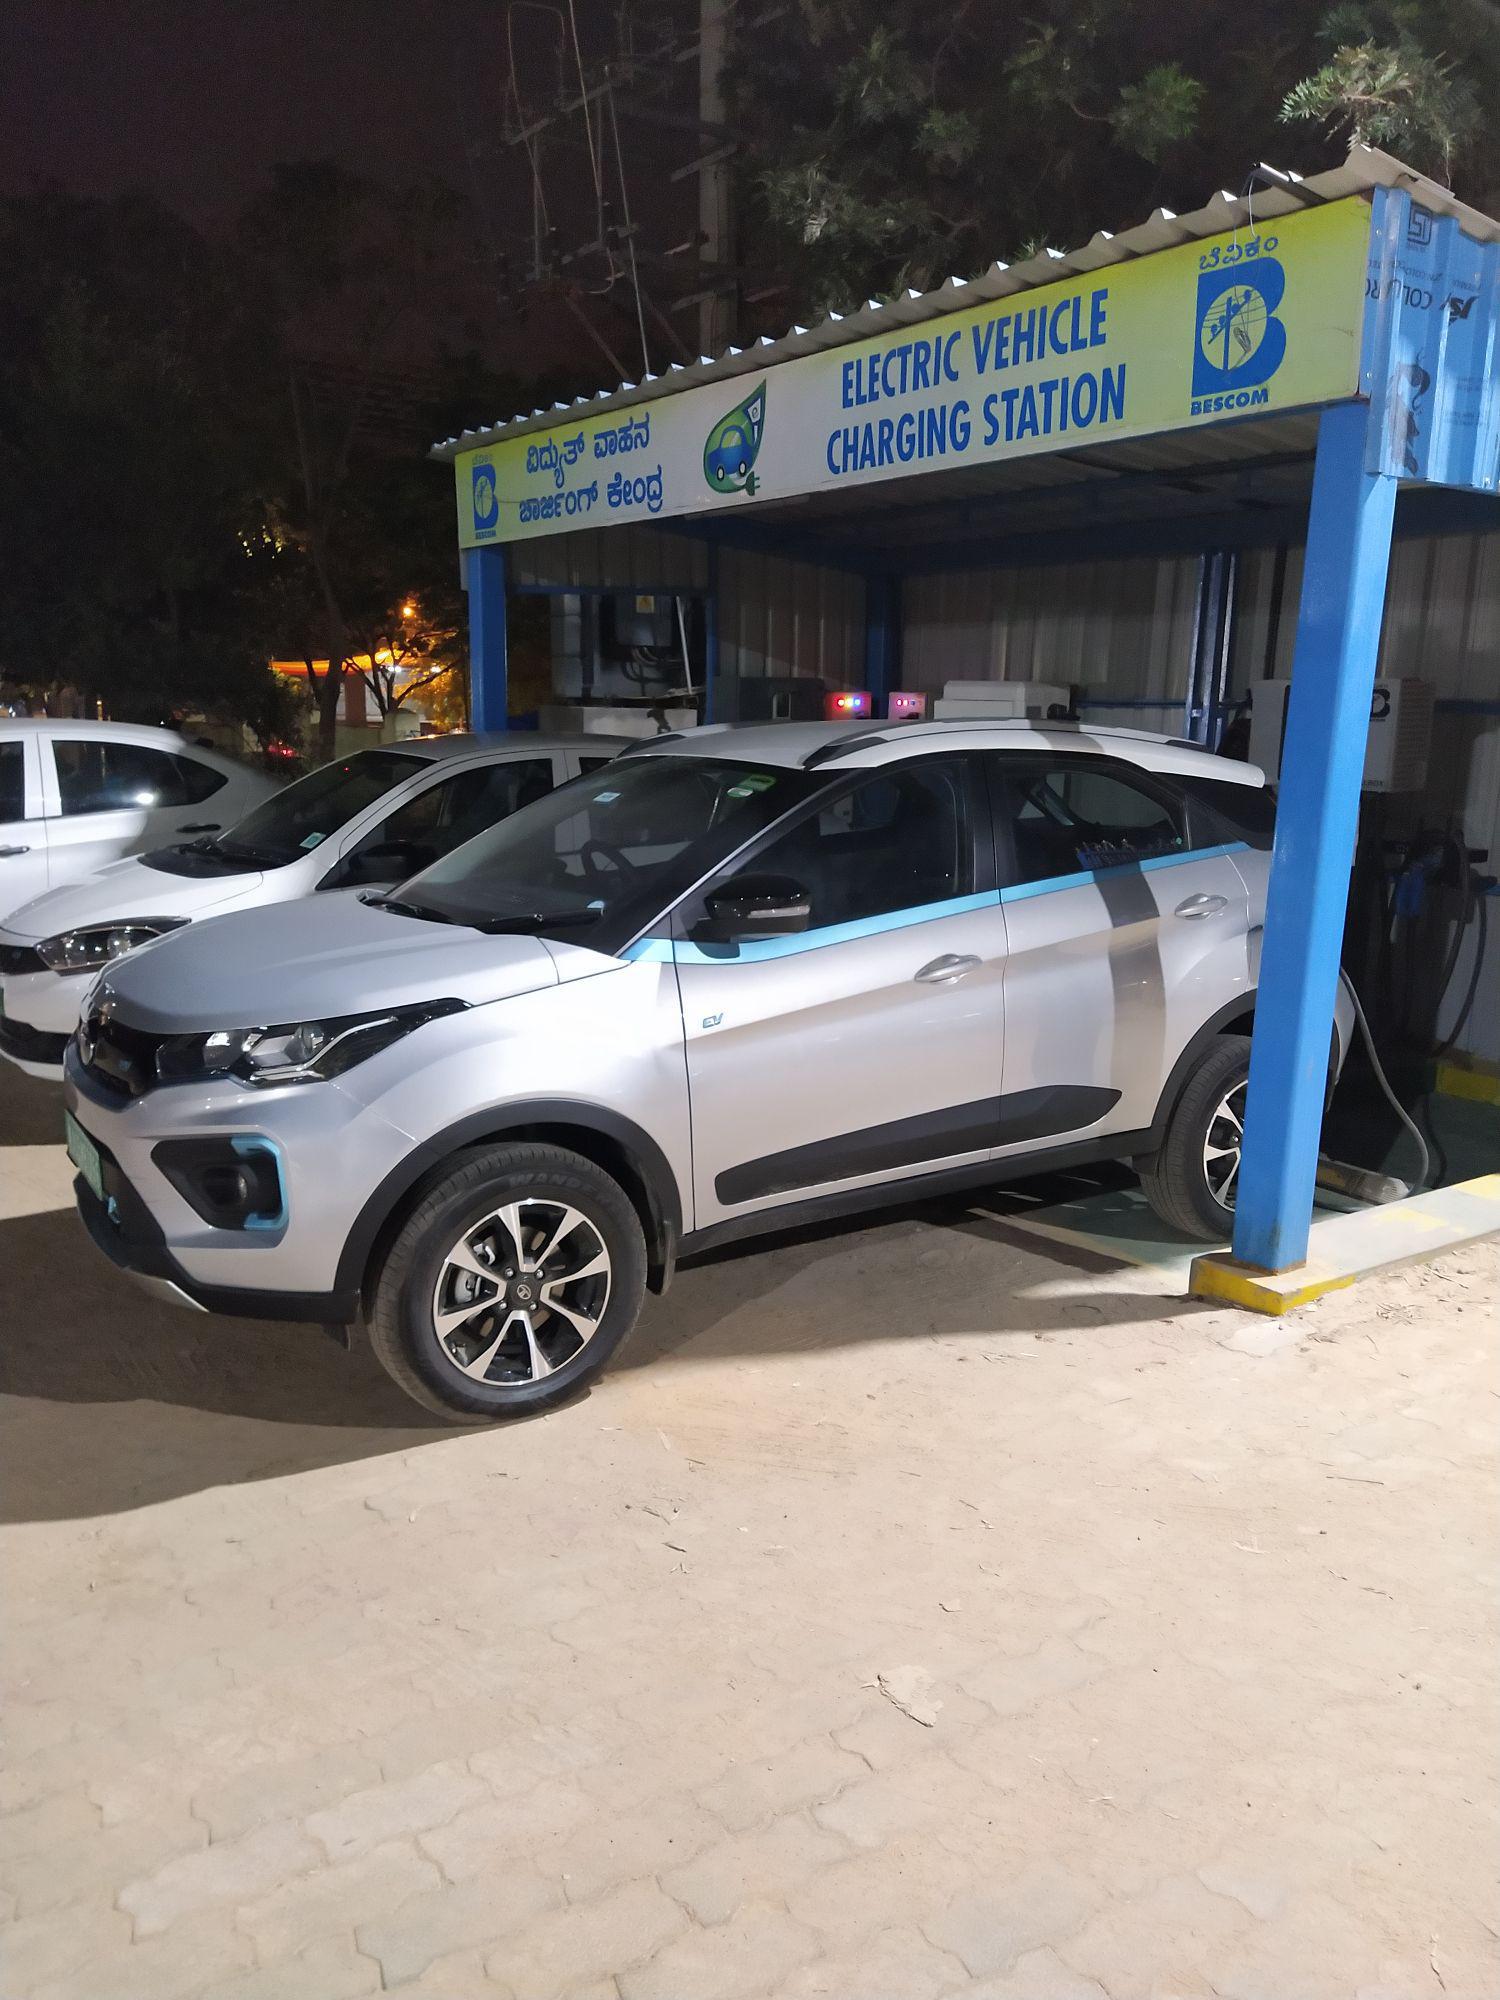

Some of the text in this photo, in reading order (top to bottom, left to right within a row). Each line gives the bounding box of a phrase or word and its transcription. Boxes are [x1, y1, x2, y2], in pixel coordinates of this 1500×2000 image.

[842, 288, 1109, 408] ELECTRIC VEHICLE
[827, 363, 1126, 475] CHARGING STATION
[1190, 388, 1269, 416] BESCOM
[526, 411, 650, 489] ವಿದ್ಯುತ್ ವಾಹನ
[607, 464, 663, 513] ಕೇಂದ್ರ
